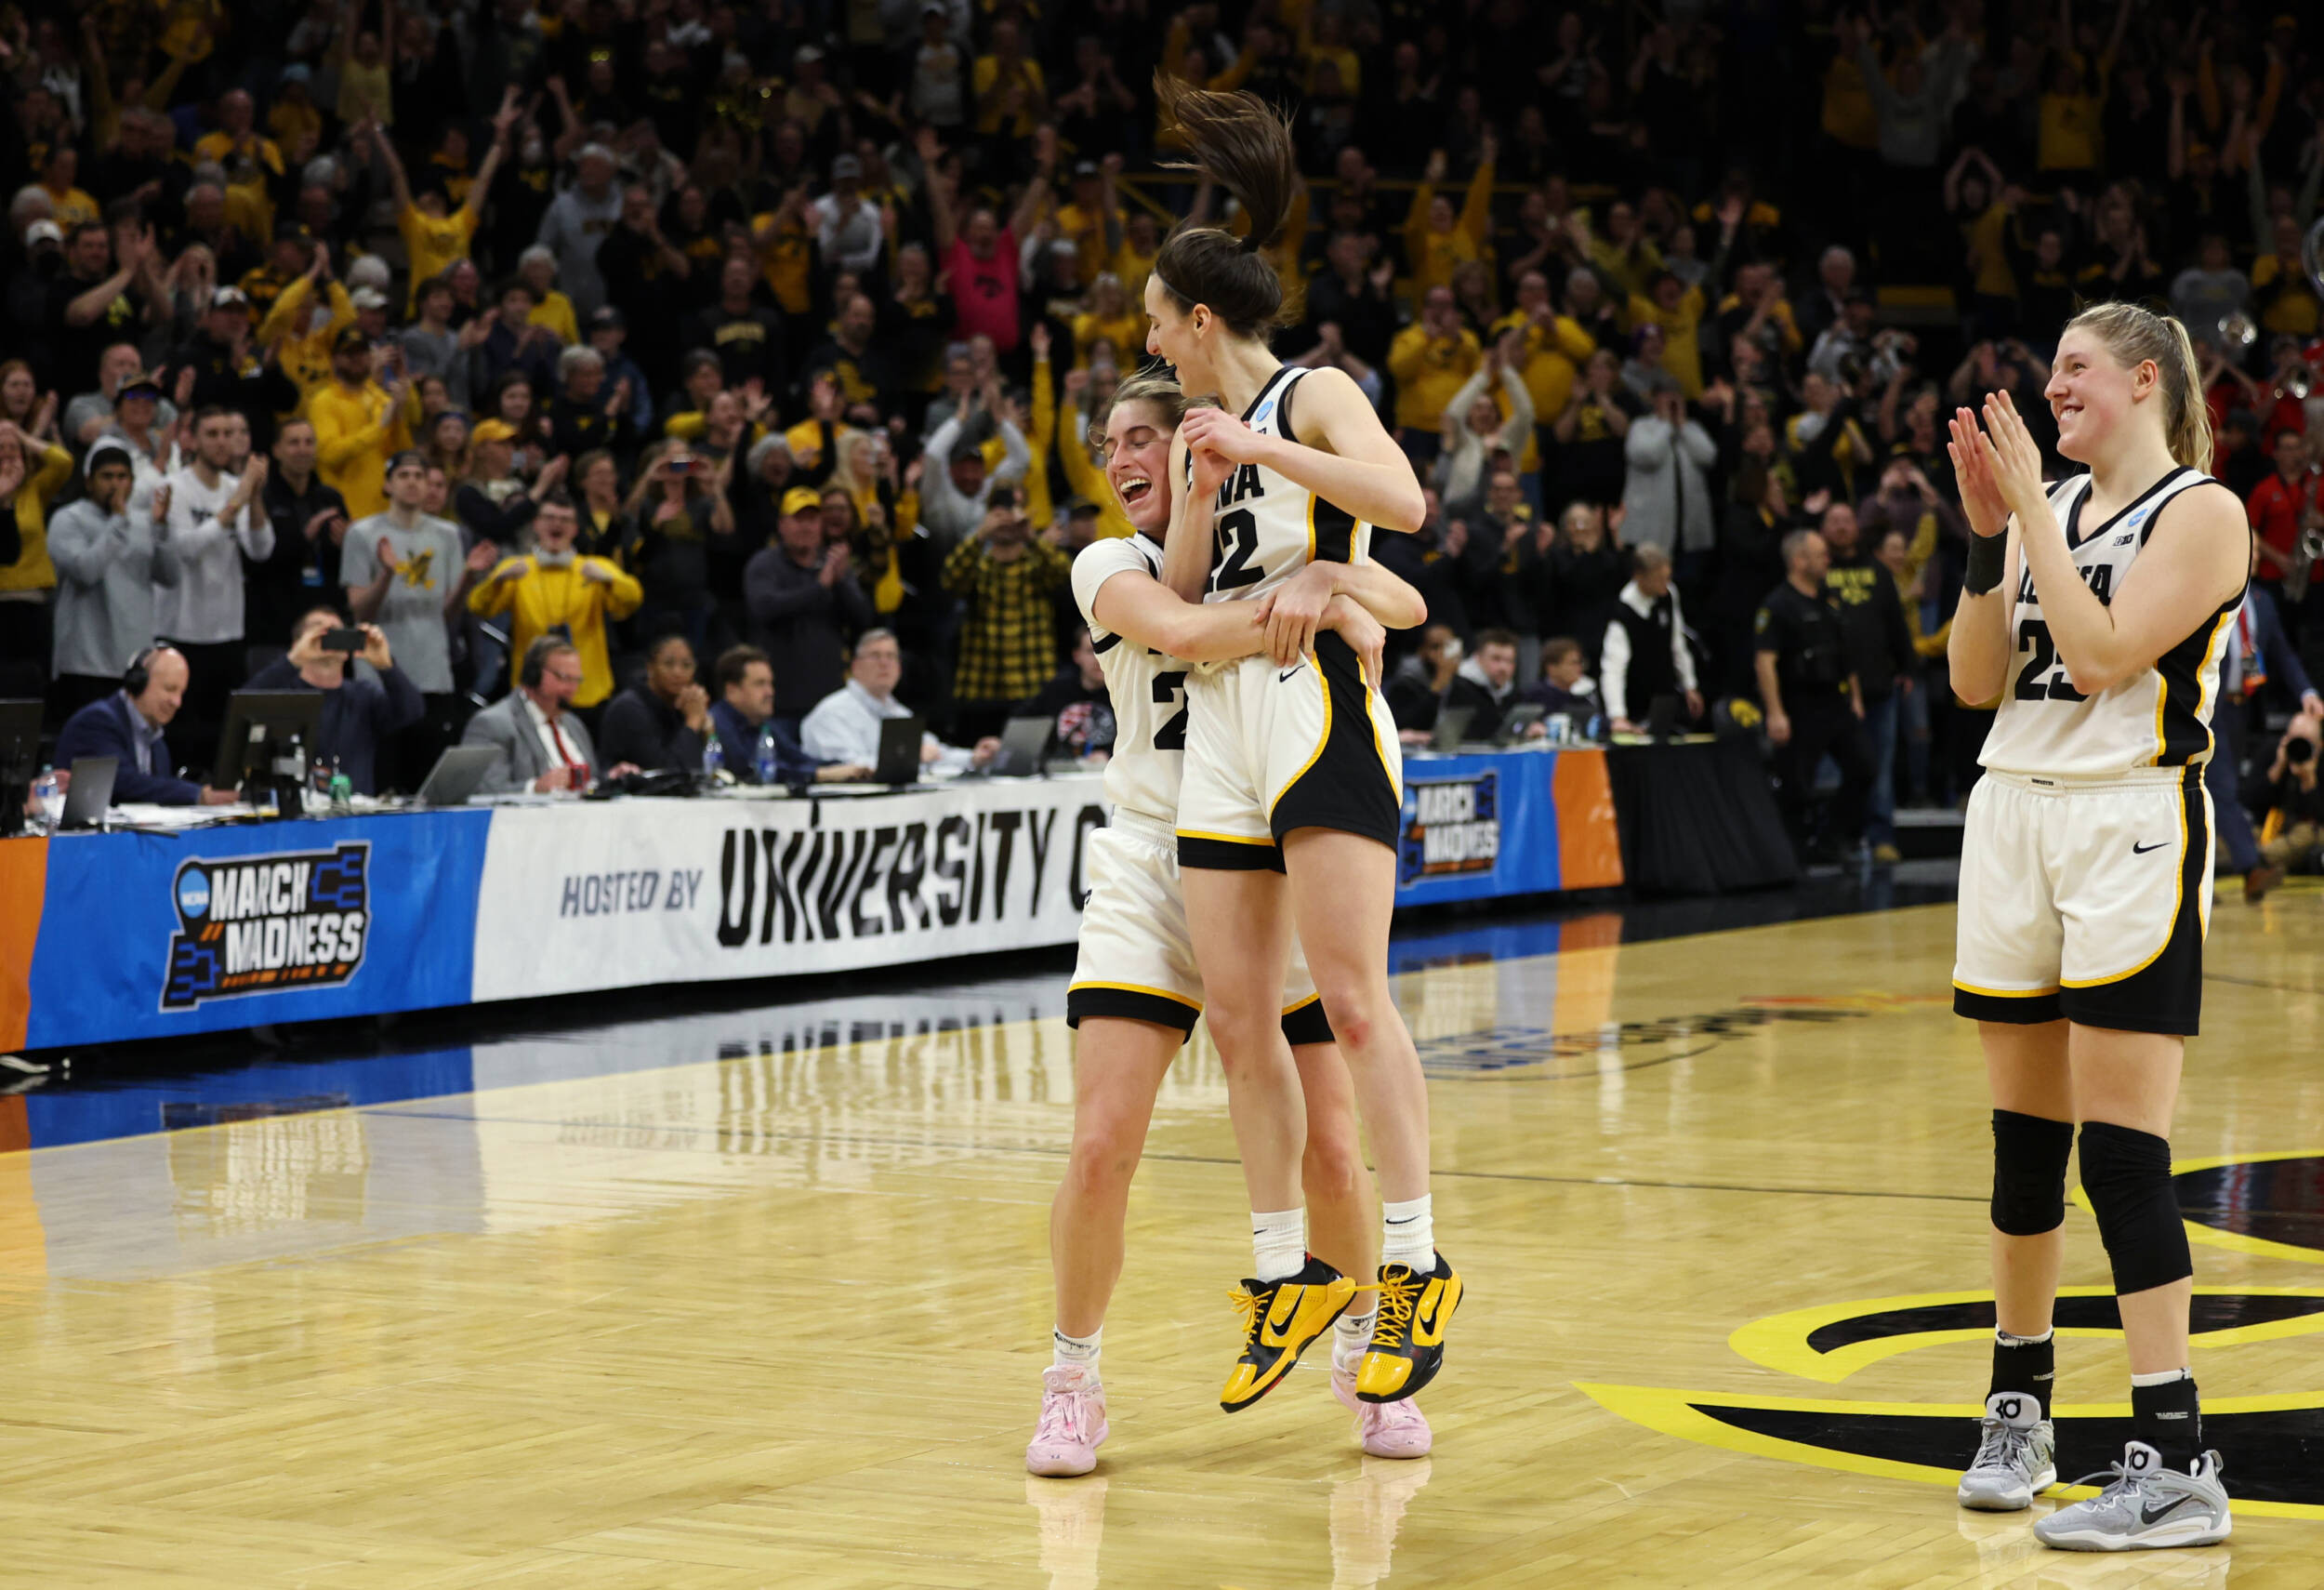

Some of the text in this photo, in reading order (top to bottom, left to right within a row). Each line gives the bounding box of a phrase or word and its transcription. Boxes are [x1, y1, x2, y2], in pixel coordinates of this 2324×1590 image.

[210, 861, 310, 921] MARCH
[561, 868, 703, 917] HOSTED BY
[717, 807, 1057, 947] UNIVERSITY
[225, 911, 364, 974] MADNESS
